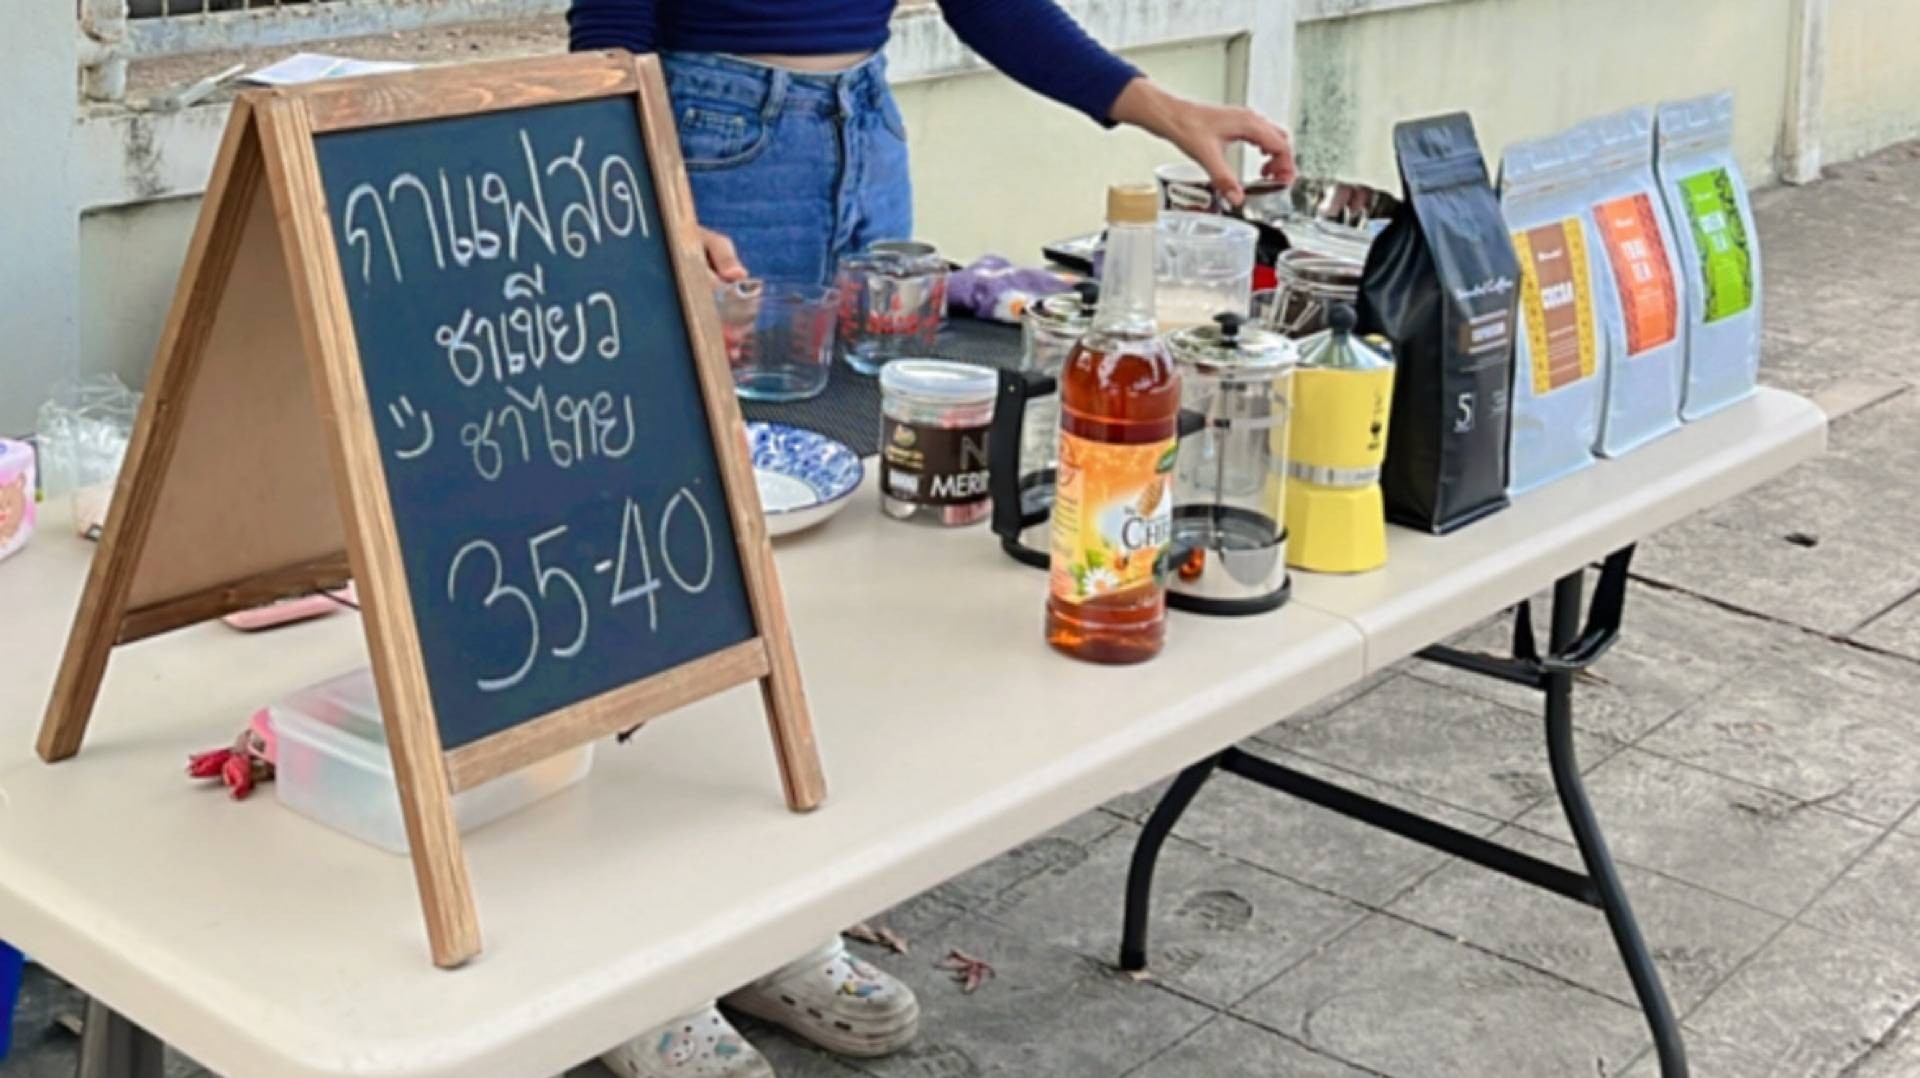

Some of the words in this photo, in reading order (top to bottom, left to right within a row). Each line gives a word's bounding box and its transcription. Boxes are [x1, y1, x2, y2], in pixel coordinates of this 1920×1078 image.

[345, 129, 648, 283] กาแฟสด
[435, 263, 620, 386] ชาเขียว
[461, 385, 635, 481] ชาไทย
[448, 487, 713, 692] 35-40
